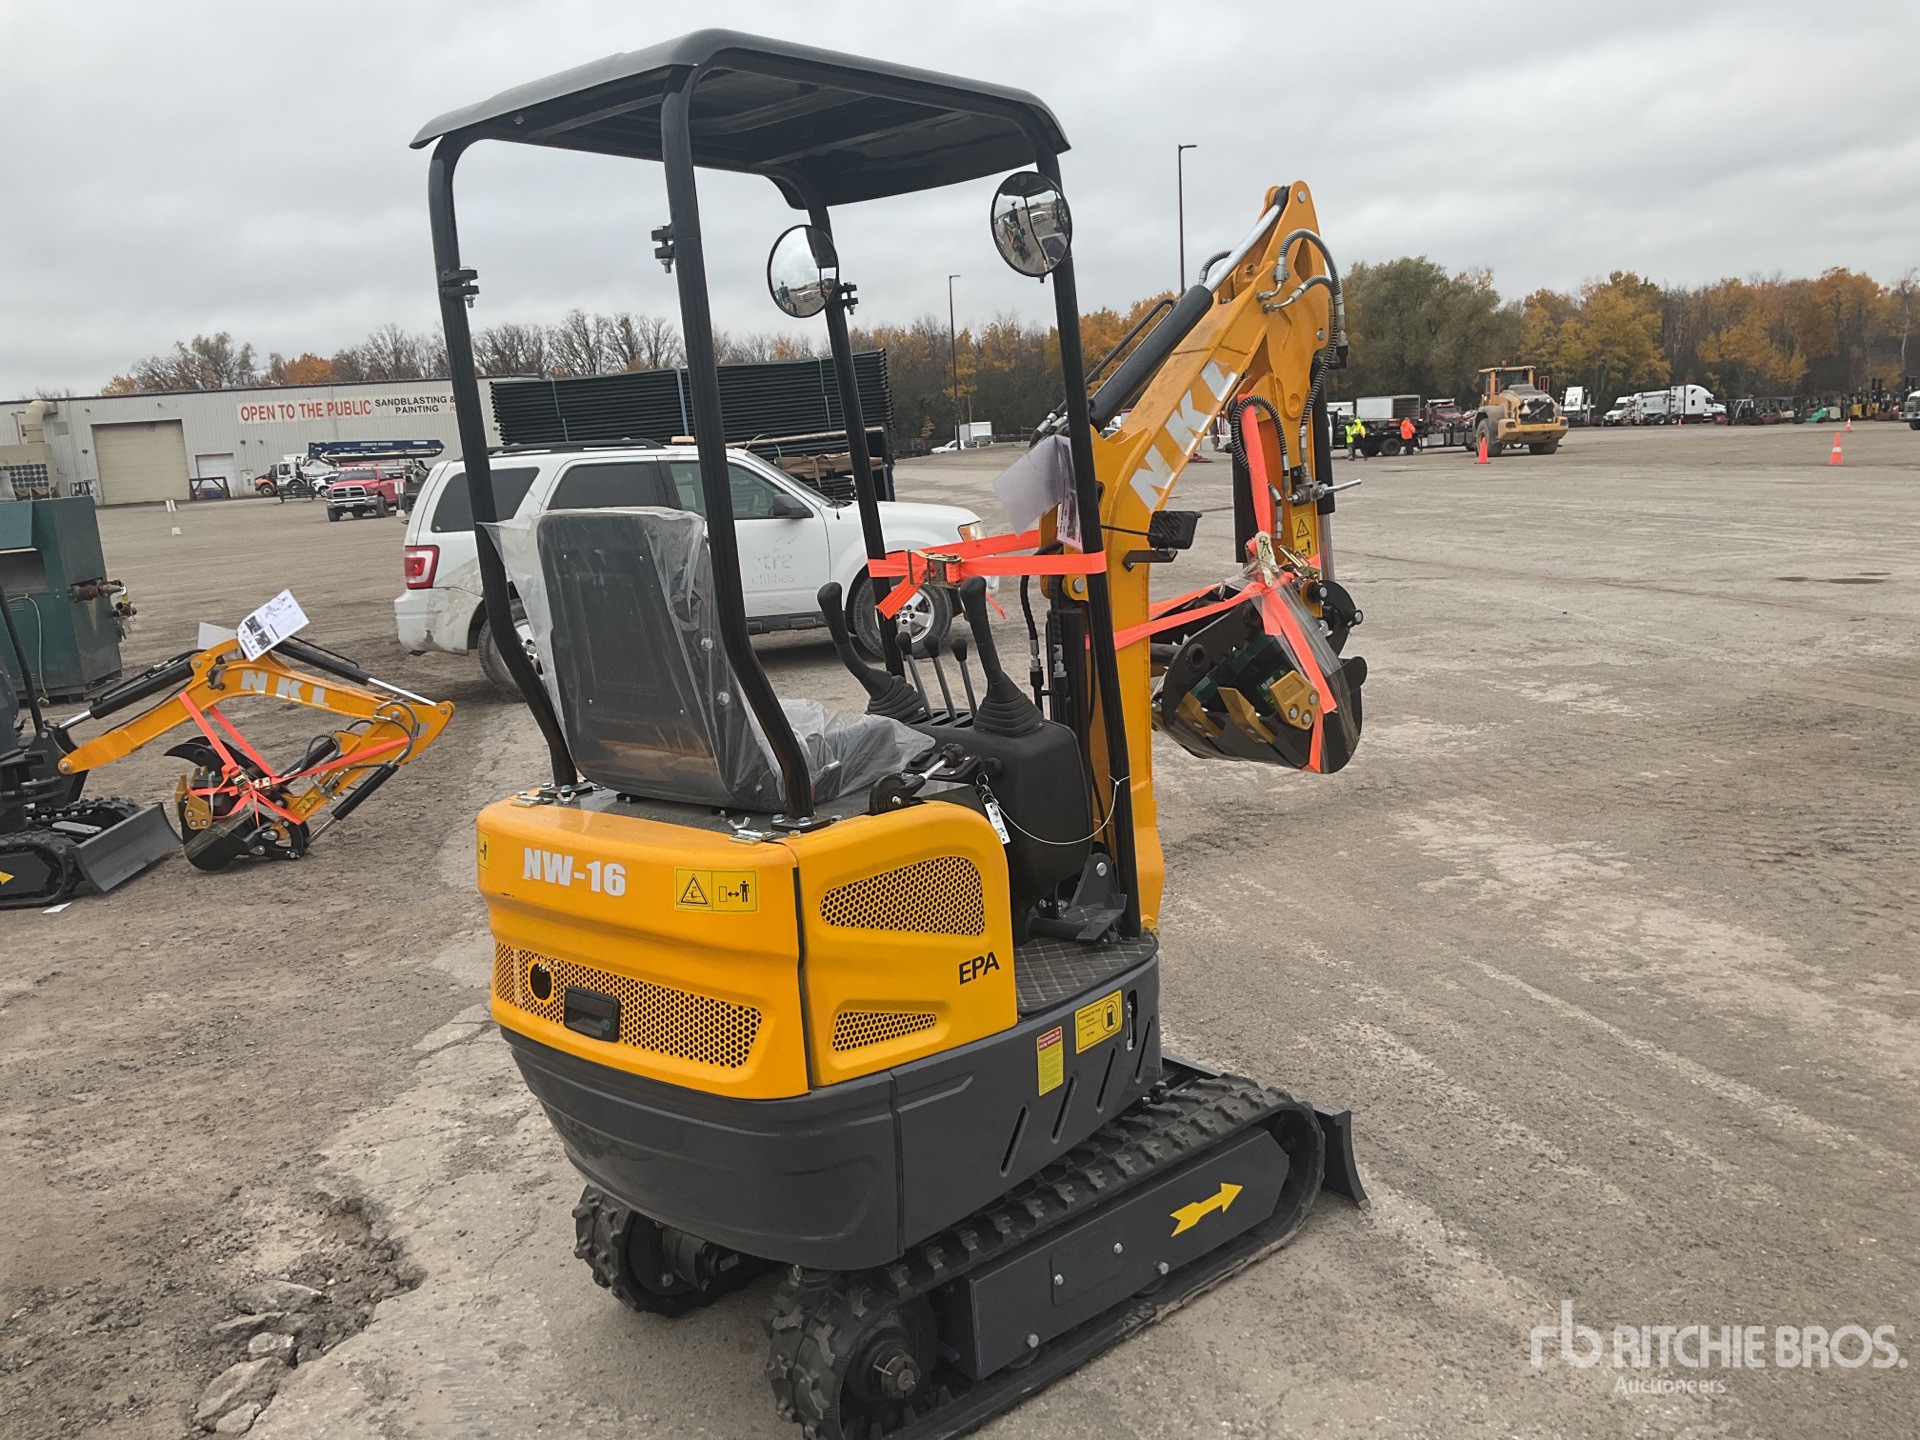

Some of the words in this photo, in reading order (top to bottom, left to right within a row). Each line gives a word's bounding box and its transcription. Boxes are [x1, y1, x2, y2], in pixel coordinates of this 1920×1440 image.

[240, 405, 276, 422] OPEN
[278, 404, 296, 420] TO
[299, 402, 324, 418] THE
[327, 400, 372, 417] PUBLIC
[374, 396, 447, 407] SANDBLASTING
[395, 405, 440, 414] PAINTING
[1129, 359, 1239, 514] NKL
[240, 669, 330, 708] NKL
[522, 847, 626, 896] NW-16
[959, 951, 1000, 985] EPA
